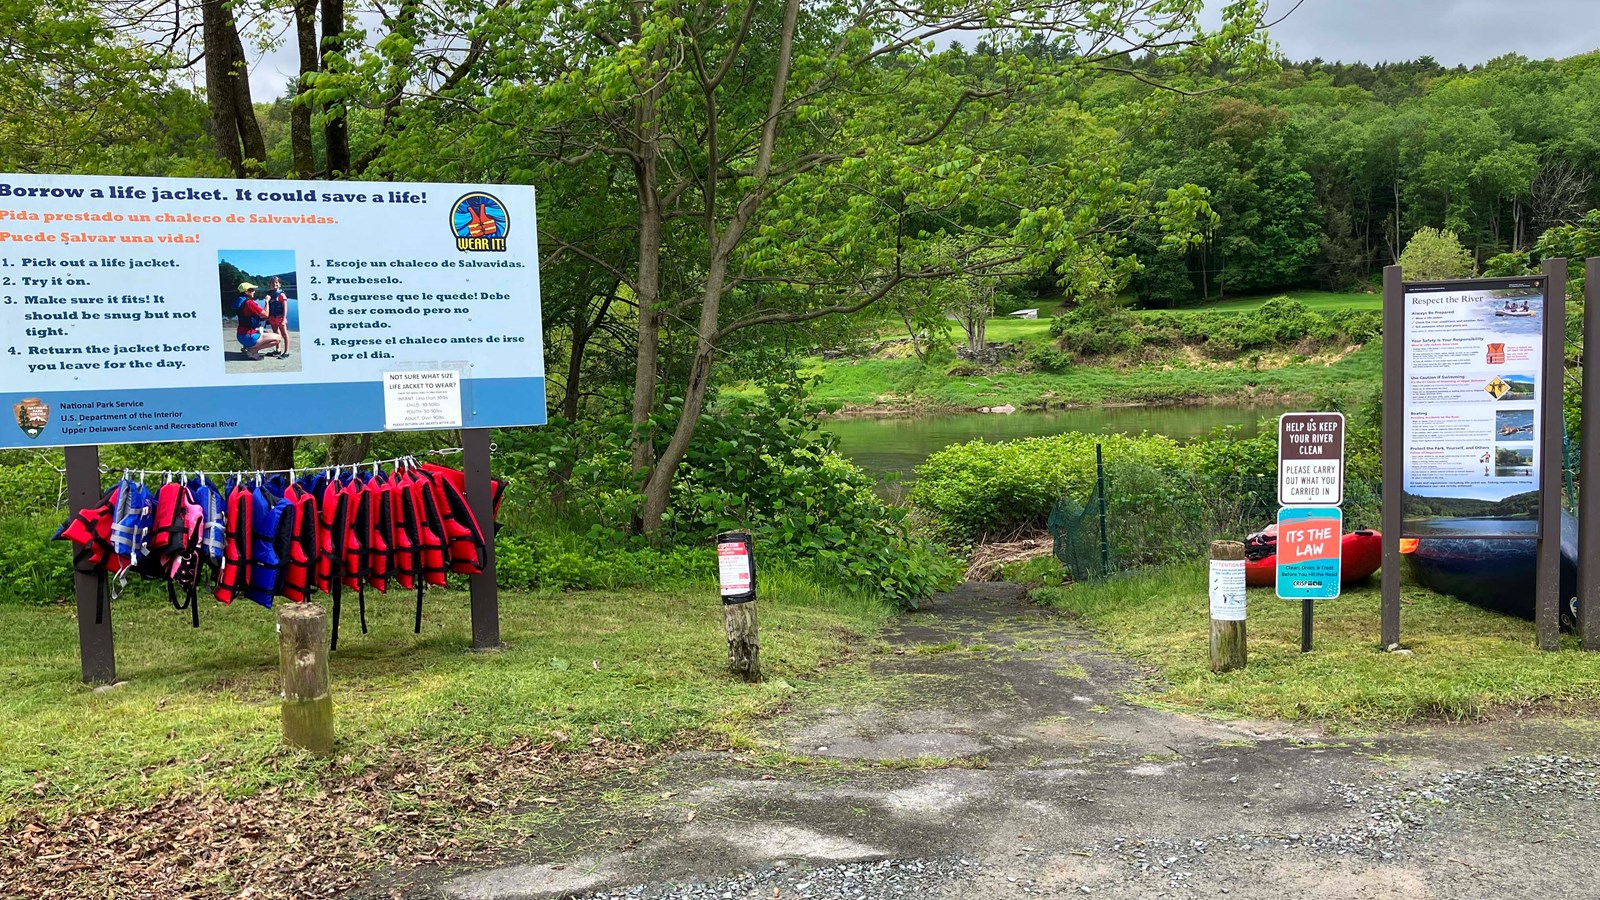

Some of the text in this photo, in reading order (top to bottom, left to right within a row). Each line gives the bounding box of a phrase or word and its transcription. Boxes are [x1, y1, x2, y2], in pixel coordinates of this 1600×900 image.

[0, 184, 426, 203] Borrow a life jacket. It could save a life!
[0, 211, 39, 221] Pida
[44, 212, 124, 223] prestado
[155, 213, 221, 223] chaleco
[226, 214, 245, 223] de
[250, 214, 338, 224] Salvavidas.
[0, 232, 56, 242] Puede
[61, 233, 116, 242] Salvar
[158, 234, 200, 243] vida!
[458, 238, 505, 250] WEAR IT!
[3, 258, 14, 266] 1.
[22, 258, 56, 267] Pick
[102, 259, 125, 267] life
[130, 259, 179, 269] jacket.
[326, 260, 367, 269] Escoje
[3, 277, 16, 285] 2.
[22, 277, 48, 287] Try
[52, 277, 62, 285] it
[4, 296, 17, 304] 3.
[25, 296, 66, 304] Make
[328, 293, 393, 302] Asegurese
[436, 293, 477, 302] quede!
[1412, 298, 1443, 306] Respect
[25, 312, 78, 320] should
[330, 321, 391, 331] apretado.
[26, 328, 68, 338] tight.
[331, 338, 382, 347] Regrese
[8, 347, 21, 355] 4.
[114, 345, 160, 355] jacket
[163, 344, 210, 352] before
[28, 364, 56, 373] you
[157, 360, 186, 369] day.
[62, 427, 87, 435] Upper
[1286, 422, 1337, 431] HELP US KEEP
[1290, 434, 1333, 443] YOUR RIVER
[1299, 446, 1322, 454] CLEAN
[1286, 528, 1332, 543] ITS THE
[1296, 543, 1324, 557] LAW
